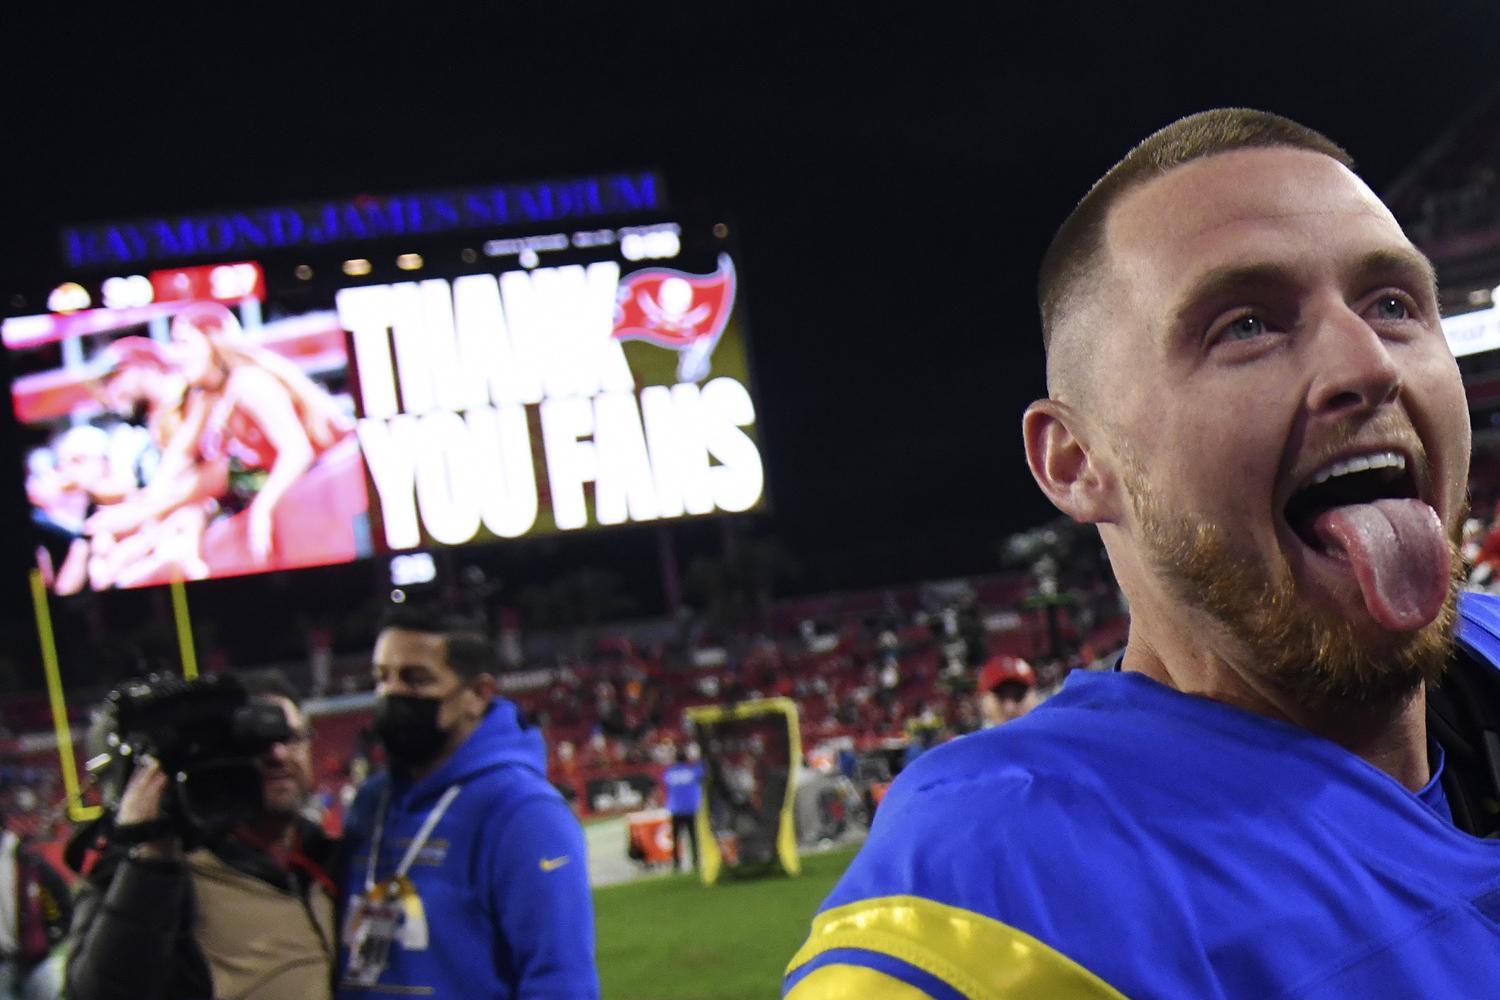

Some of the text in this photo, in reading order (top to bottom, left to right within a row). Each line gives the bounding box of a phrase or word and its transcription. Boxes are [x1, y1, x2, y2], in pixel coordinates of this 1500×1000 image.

[65, 207, 304, 267] RAYMOND
[307, 193, 460, 244] JAMES
[465, 172, 657, 226] STADIUM
[336, 261, 635, 419] THANK
[357, 377, 764, 549] YOU FANS
